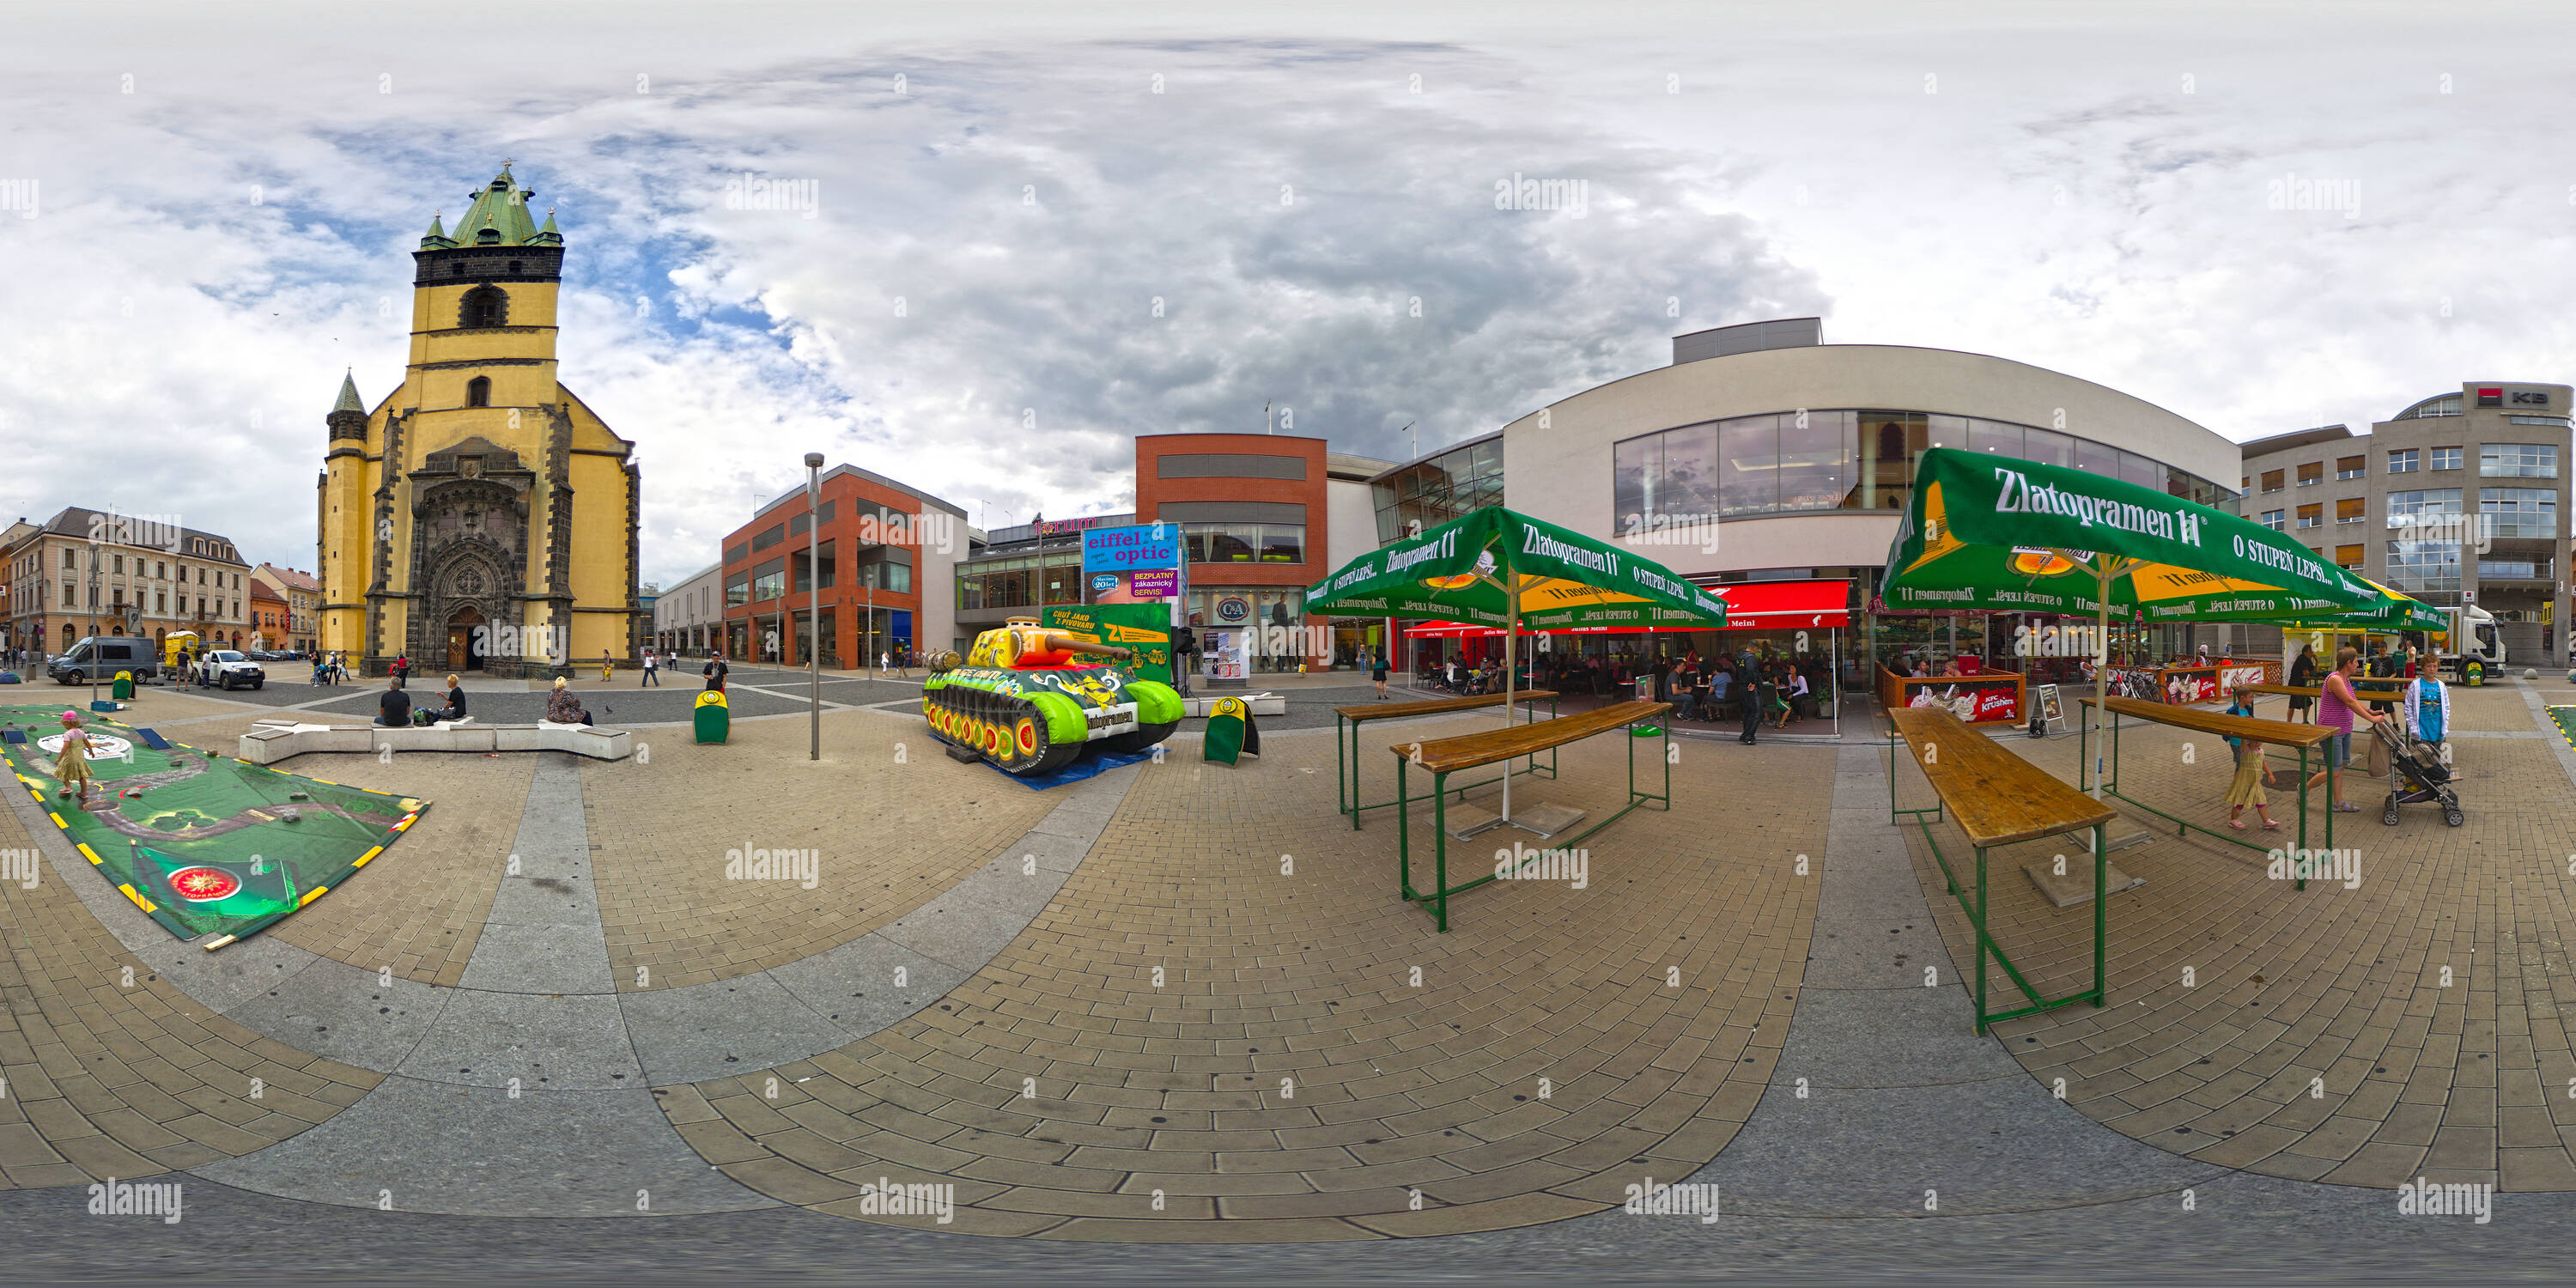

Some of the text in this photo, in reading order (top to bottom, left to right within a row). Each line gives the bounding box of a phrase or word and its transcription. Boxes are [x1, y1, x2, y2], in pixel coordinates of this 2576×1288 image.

[2512, 392, 2548, 404] KB
[1995, 466, 2174, 540] Zlatopramen
[2233, 534, 2244, 558] O
[2248, 538, 2293, 574] STUPEŇ
[1088, 532, 1141, 549] eiffel
[1115, 545, 1170, 564] optic
[1385, 539, 1440, 574] Zlatopramen
[1522, 522, 1604, 573] Zlatopramen
[1633, 566, 1640, 582] O
[1641, 568, 1666, 591] STUPEŇ
[1134, 571, 1175, 580] BEZPLATNÝ
[1134, 580, 1173, 588] zákaznický
[1053, 611, 1090, 621] CHUŤ JAKO
[1223, 604, 1244, 615] C&A
[1061, 618, 1096, 629] PIVOVARU
[1084, 710, 1133, 730] latopramen
